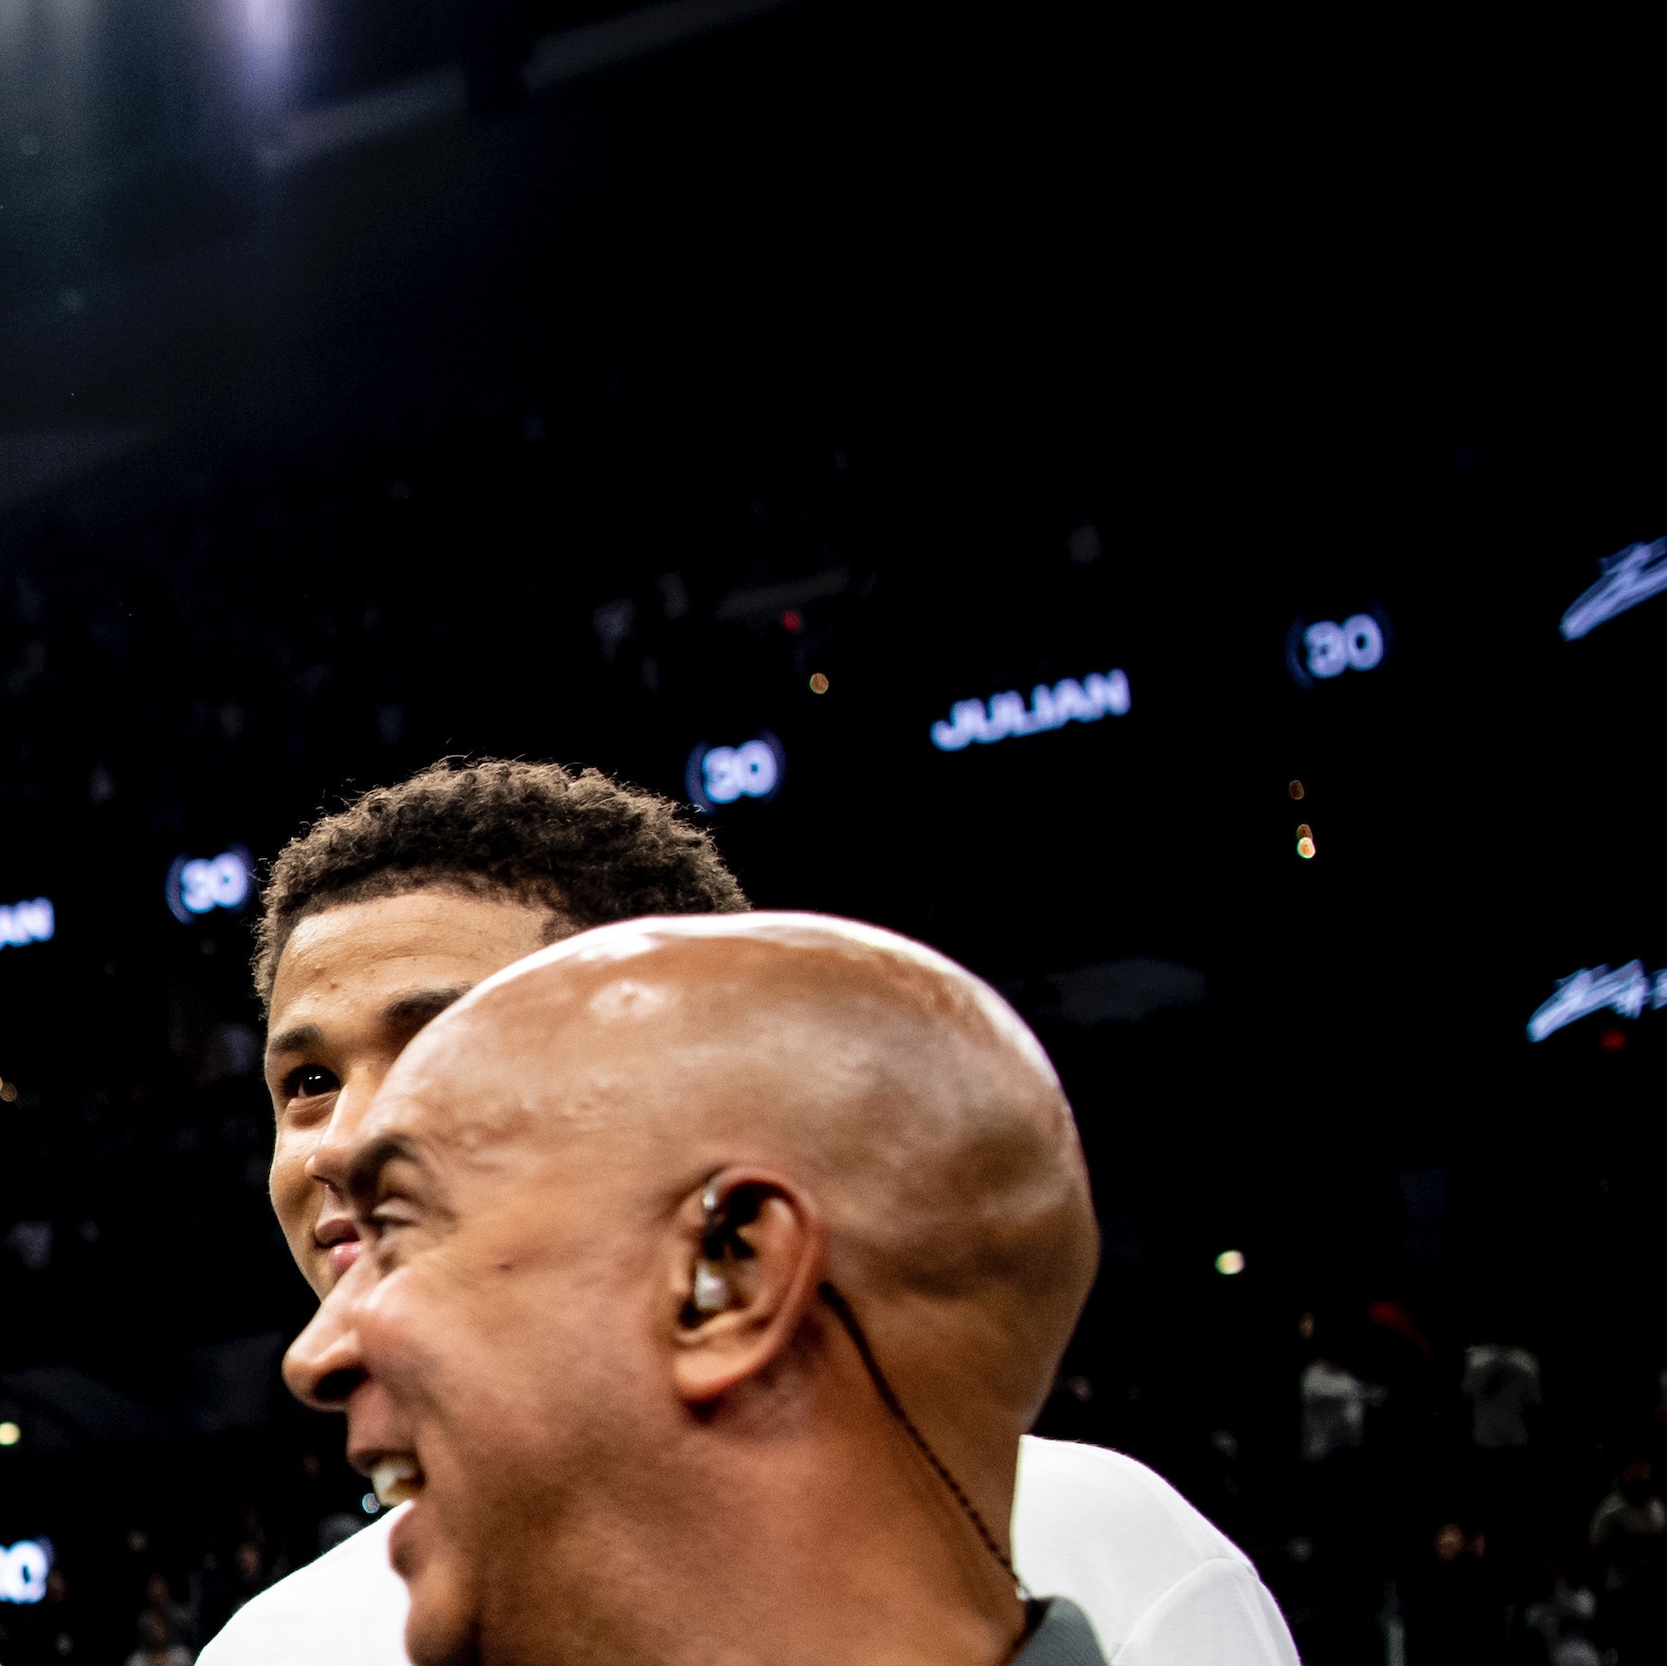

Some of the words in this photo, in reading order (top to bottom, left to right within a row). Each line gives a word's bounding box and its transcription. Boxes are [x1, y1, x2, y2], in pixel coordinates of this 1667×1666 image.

[1304, 613, 1385, 680] 30
[930, 668, 1132, 751] JULIAN
[701, 738, 778, 804] 30
[179, 851, 249, 914] 30
